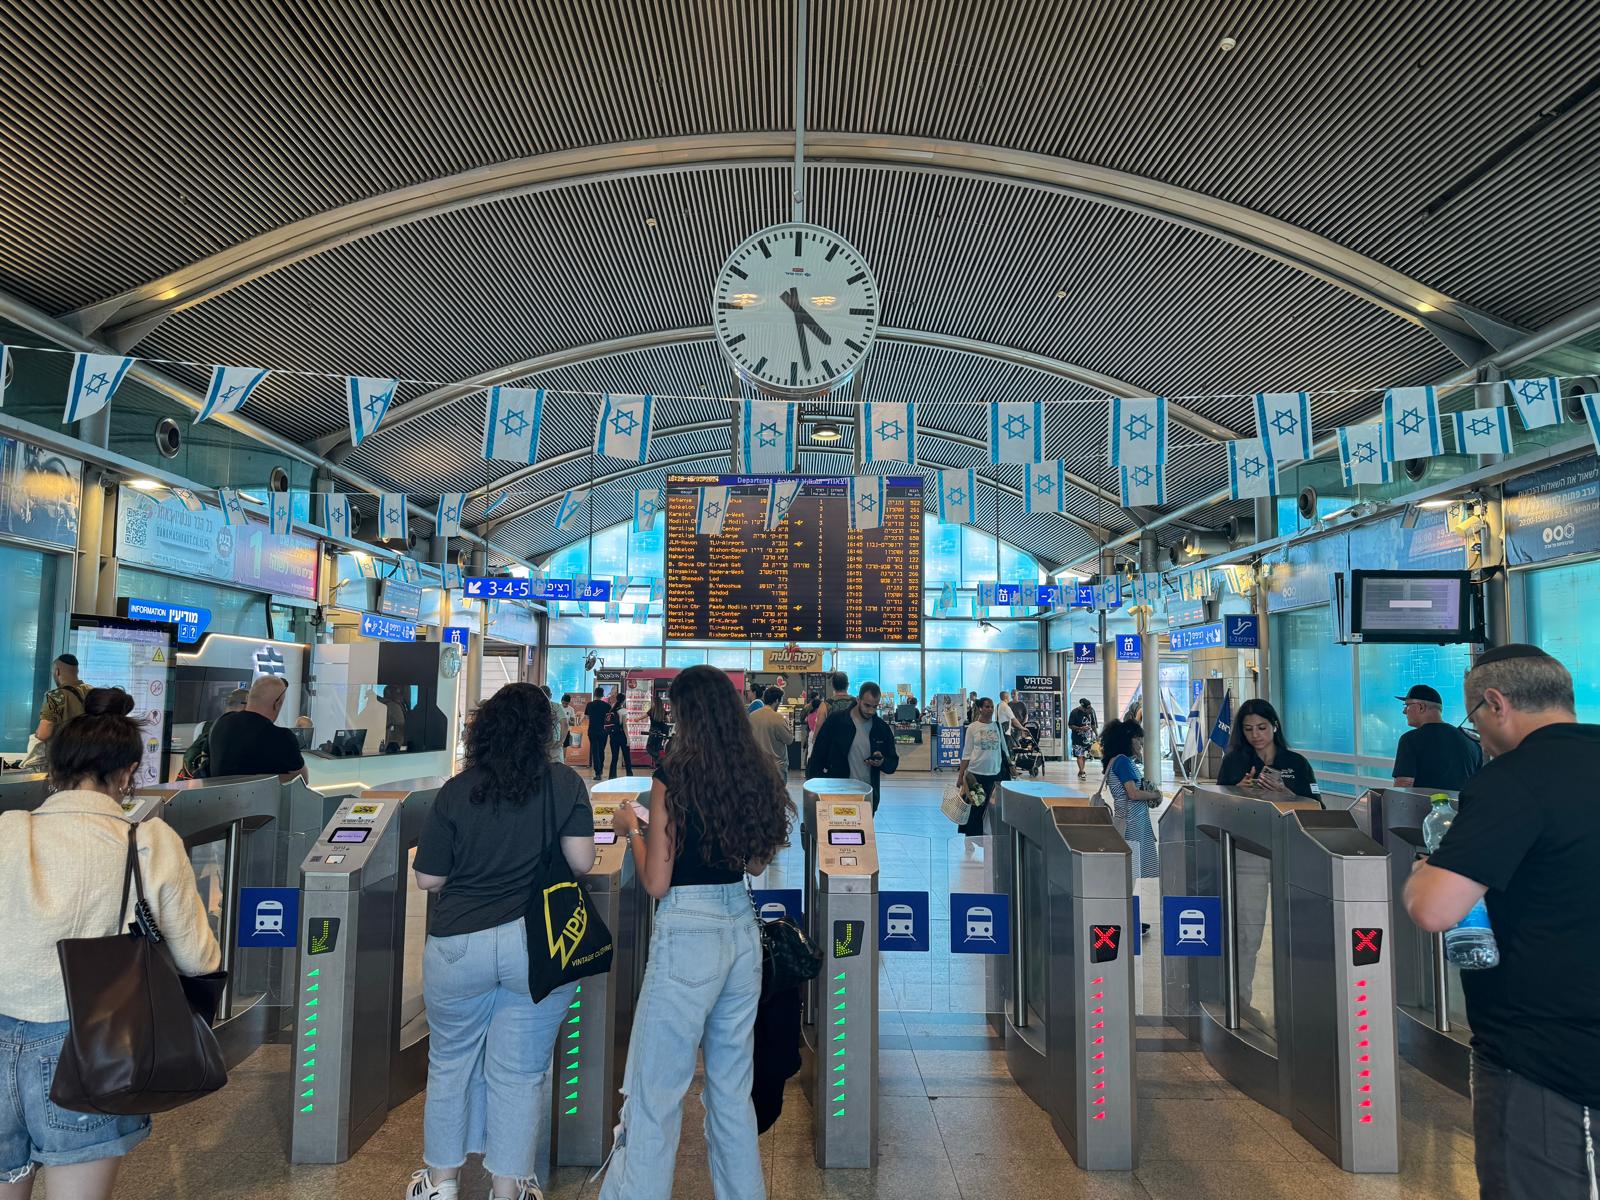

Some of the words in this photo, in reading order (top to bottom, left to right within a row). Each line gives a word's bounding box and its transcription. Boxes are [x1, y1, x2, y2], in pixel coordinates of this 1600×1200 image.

[1541, 478, 1566, 492] השאלות
[1567, 474, 1577, 484] את
[1581, 486, 1596, 496] ערב
[487, 581, 529, 597] 3-4-5
[543, 583, 570, 592] רציפי
[130, 605, 167, 617] INFORMATION
[168, 609, 199, 624] מודיעין
[377, 620, 390, 637] 3-4
[1183, 632, 1192, 647] 1-2
[769, 650, 792, 662] עלית
[794, 652, 817, 664] קפה
[571, 953, 595, 967] VINTAGE
